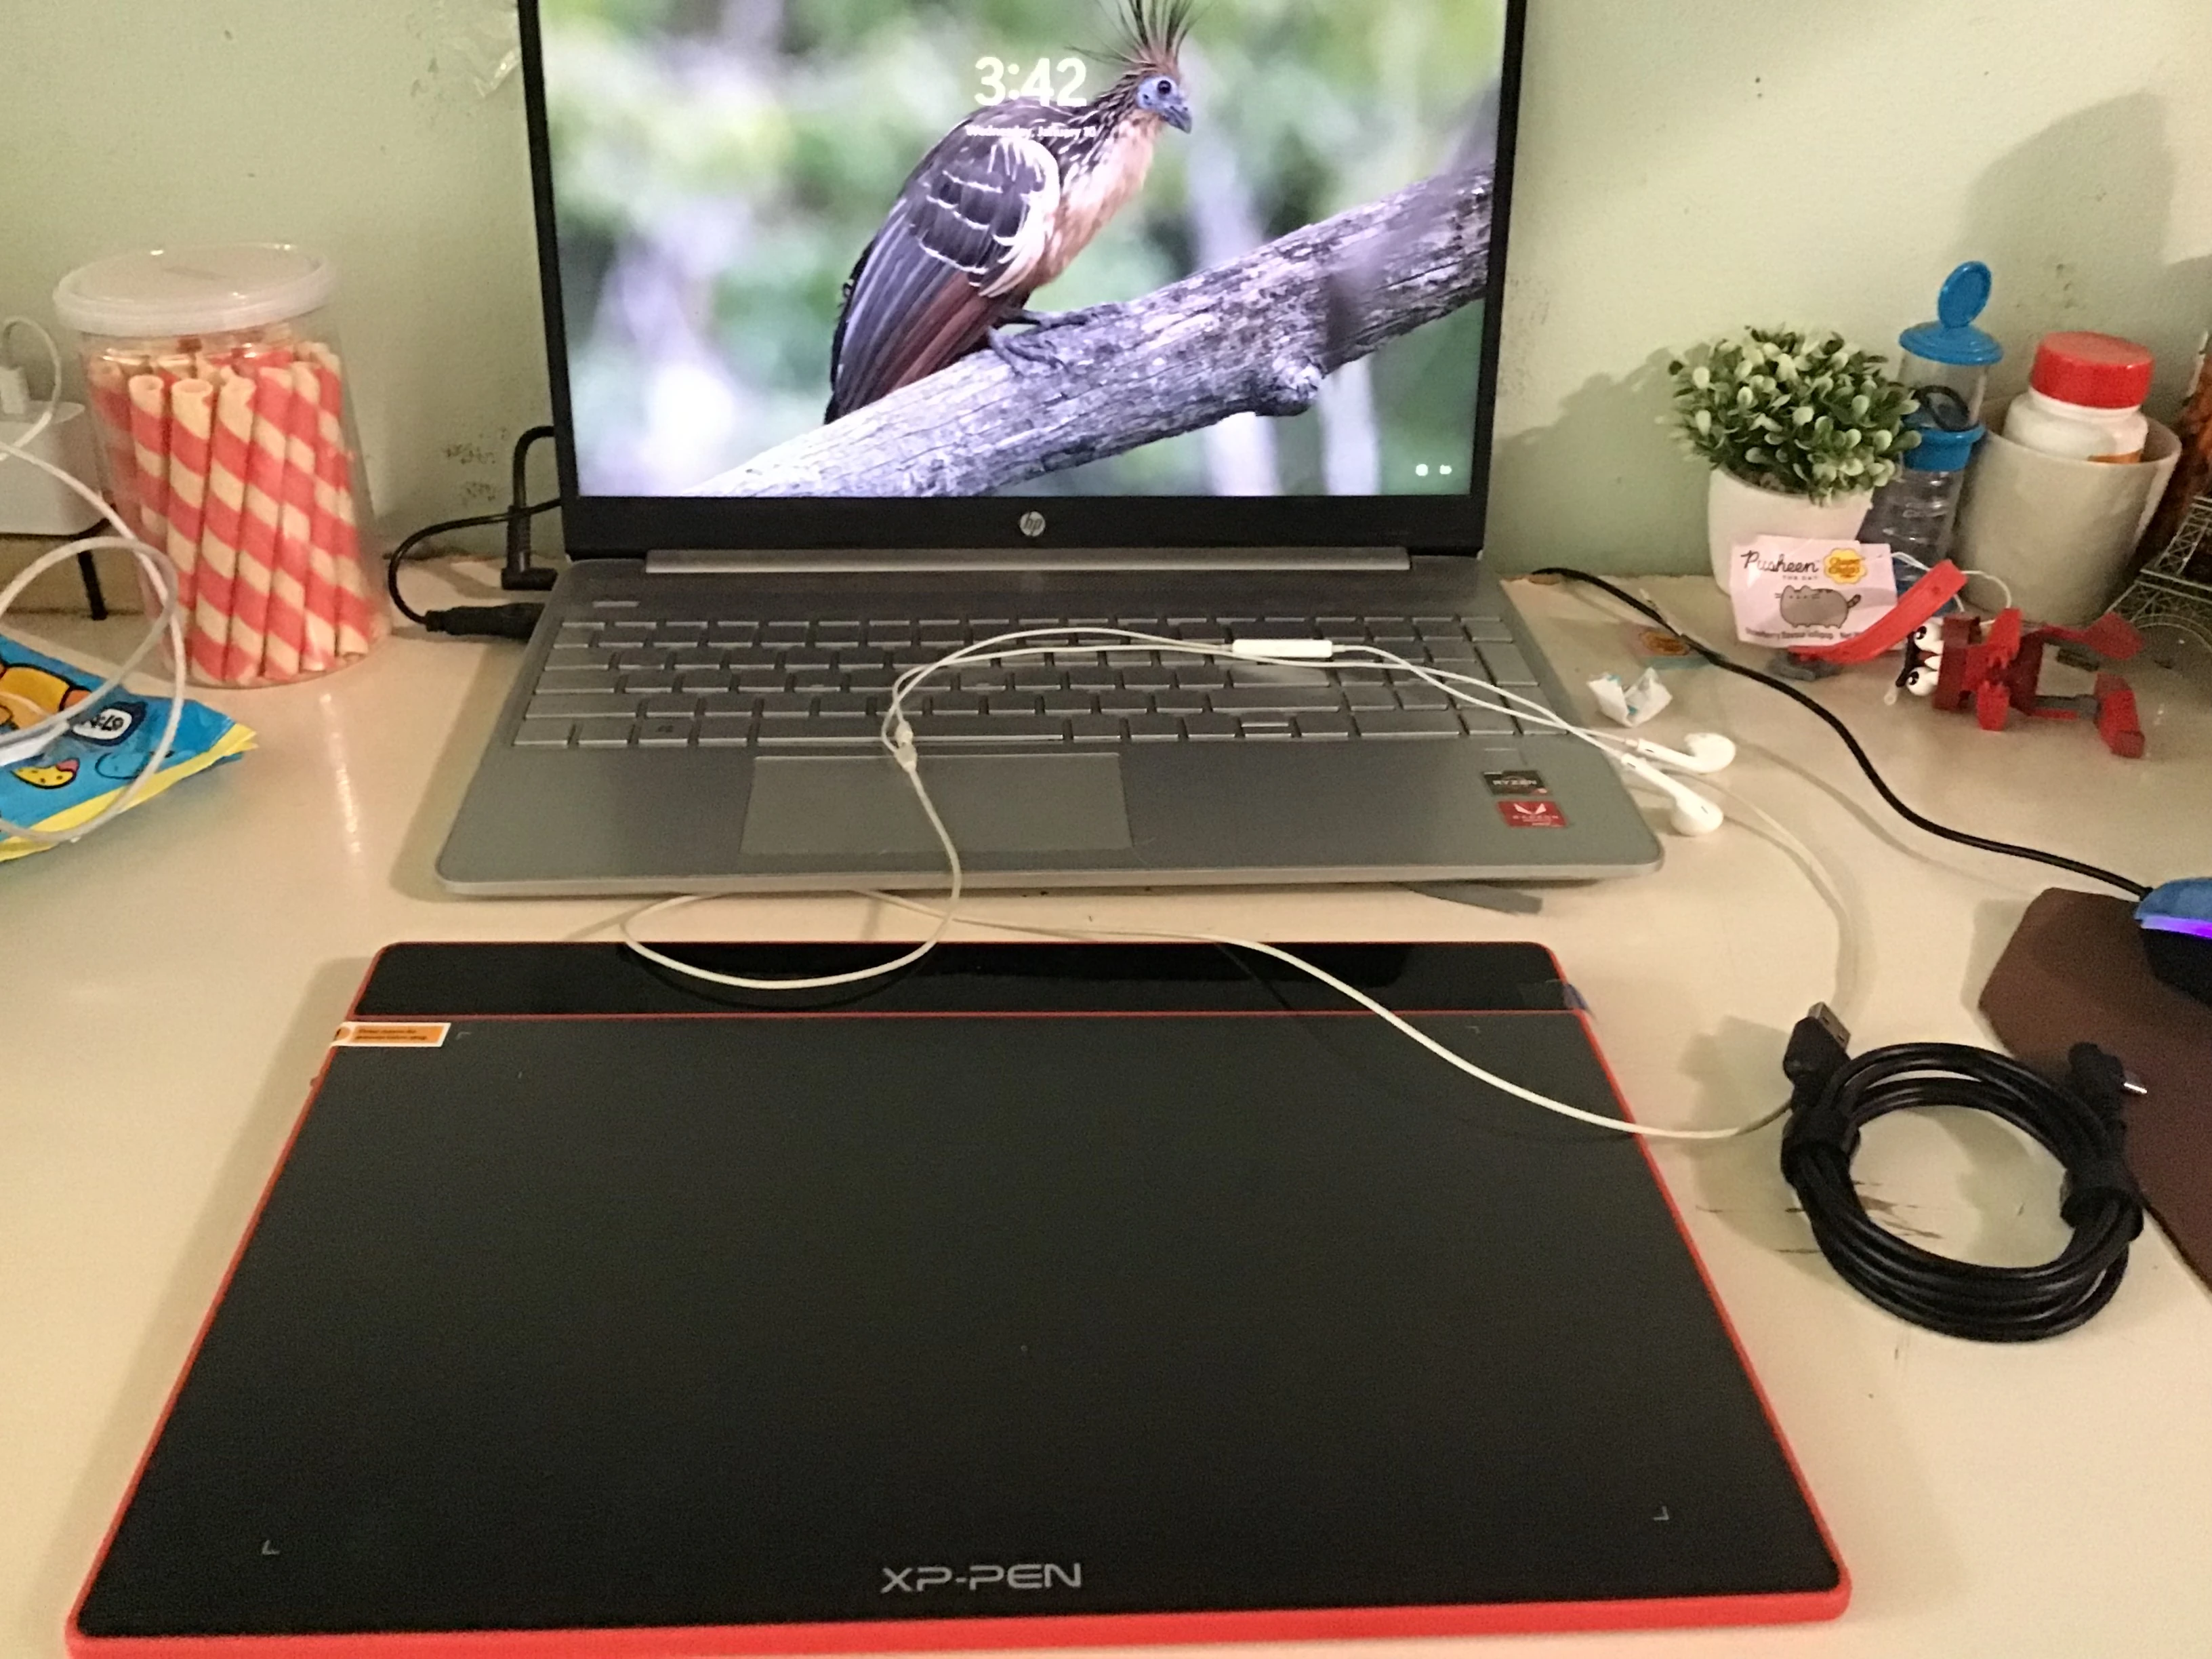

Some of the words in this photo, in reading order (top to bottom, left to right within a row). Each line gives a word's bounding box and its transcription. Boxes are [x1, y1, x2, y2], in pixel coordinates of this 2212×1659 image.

[975, 56, 1086, 106] 3:42
[1740, 550, 1819, 573] Pusheen
[880, 1563, 1081, 1593] XP-PEN
